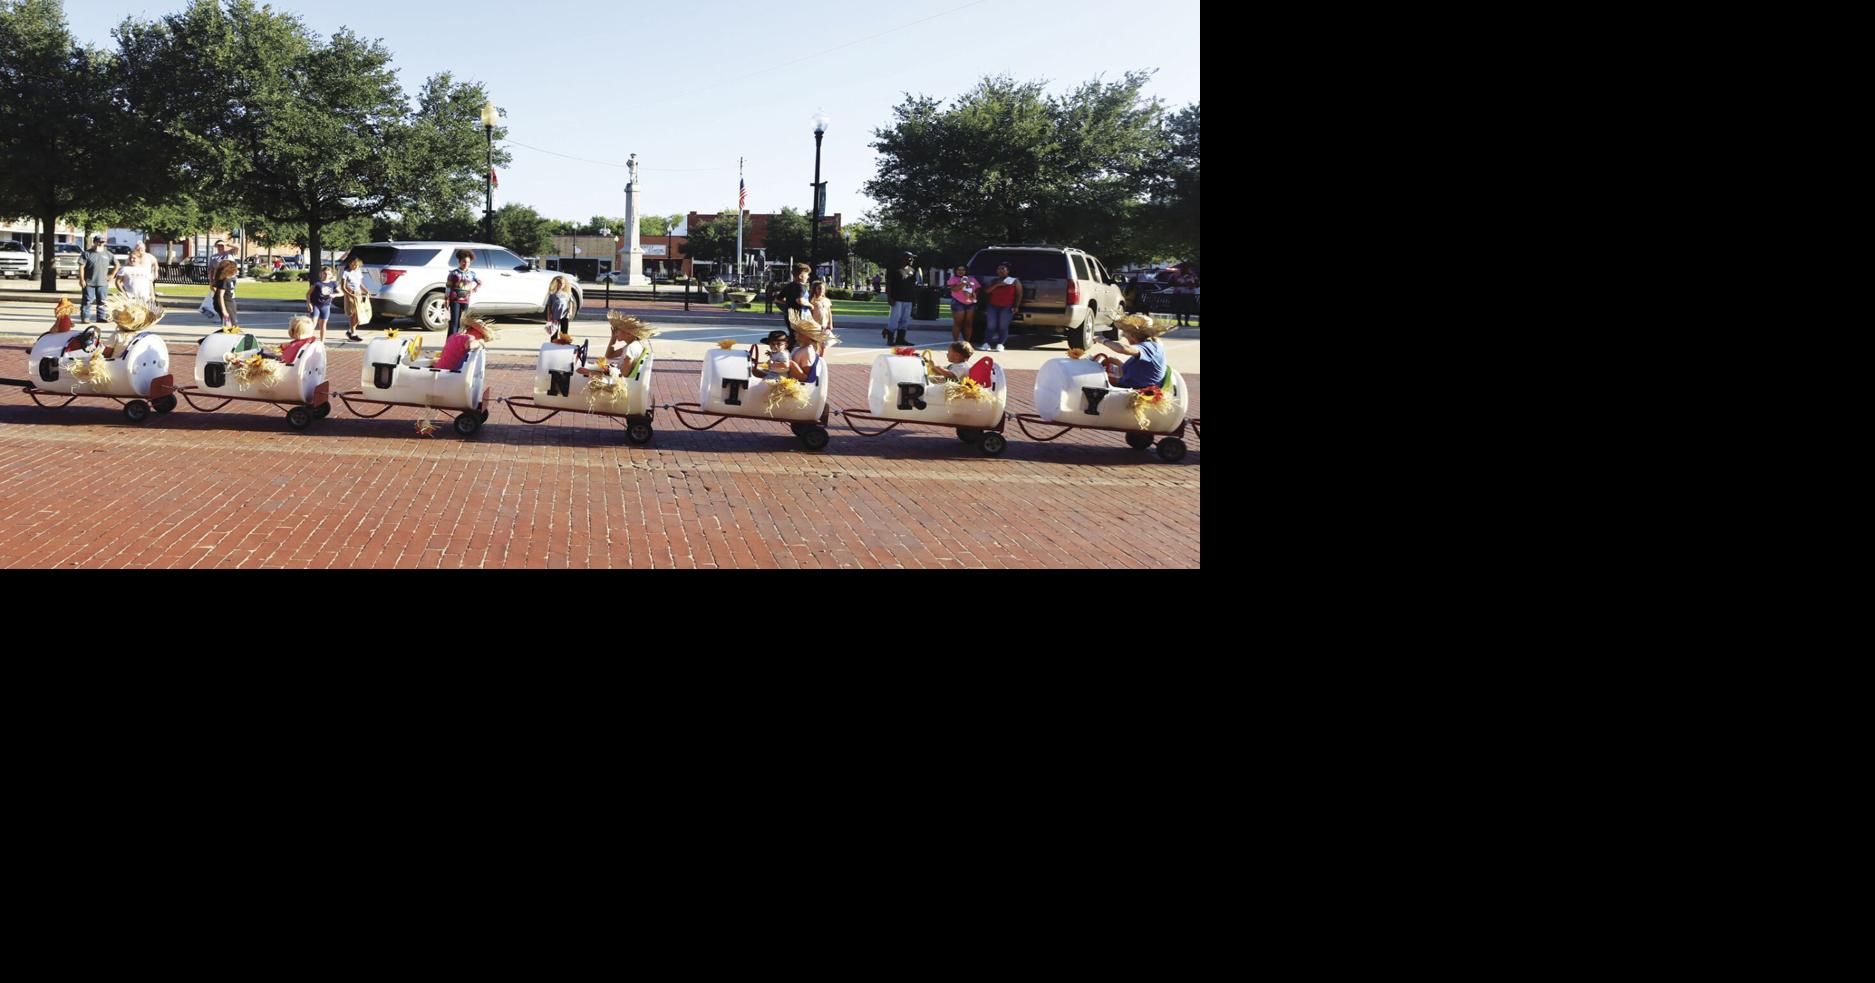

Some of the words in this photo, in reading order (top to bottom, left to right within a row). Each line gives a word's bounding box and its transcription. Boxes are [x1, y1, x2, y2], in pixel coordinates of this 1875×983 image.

[39, 357, 59, 382] C
[372, 362, 397, 389] U
[547, 370, 573, 397] N
[722, 378, 749, 406] T
[897, 381, 926, 411] R
[1082, 386, 1109, 415] Y
